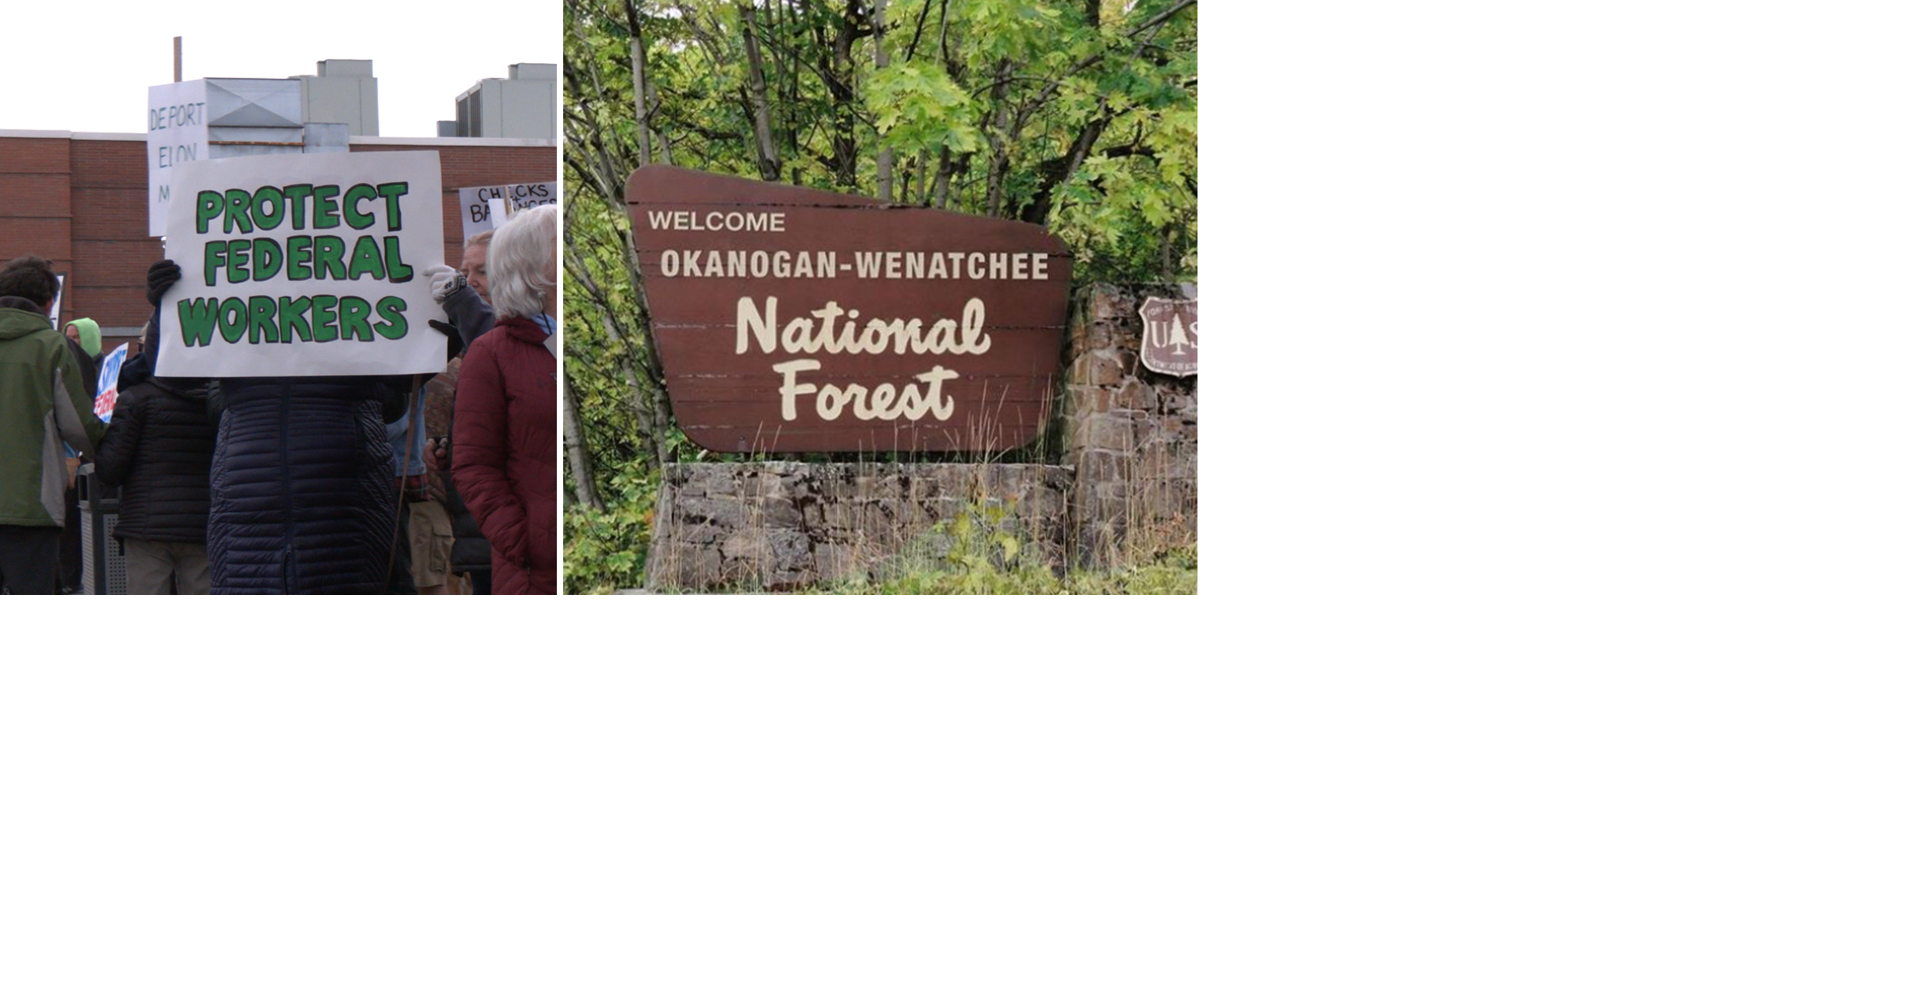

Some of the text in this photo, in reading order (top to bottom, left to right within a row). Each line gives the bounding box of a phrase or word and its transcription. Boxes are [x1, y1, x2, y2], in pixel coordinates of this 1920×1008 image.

[150, 102, 206, 131] DEPORT
[196, 182, 408, 234] PROTECT
[478, 184, 549, 206] CHCKS
[648, 211, 786, 232] WELCOME
[204, 235, 414, 287] FEDERAL
[660, 249, 1049, 280] OKANOGAN-WENATCHEE
[178, 295, 409, 348] WORKERS
[735, 296, 992, 356] National
[772, 359, 960, 421] Forest
